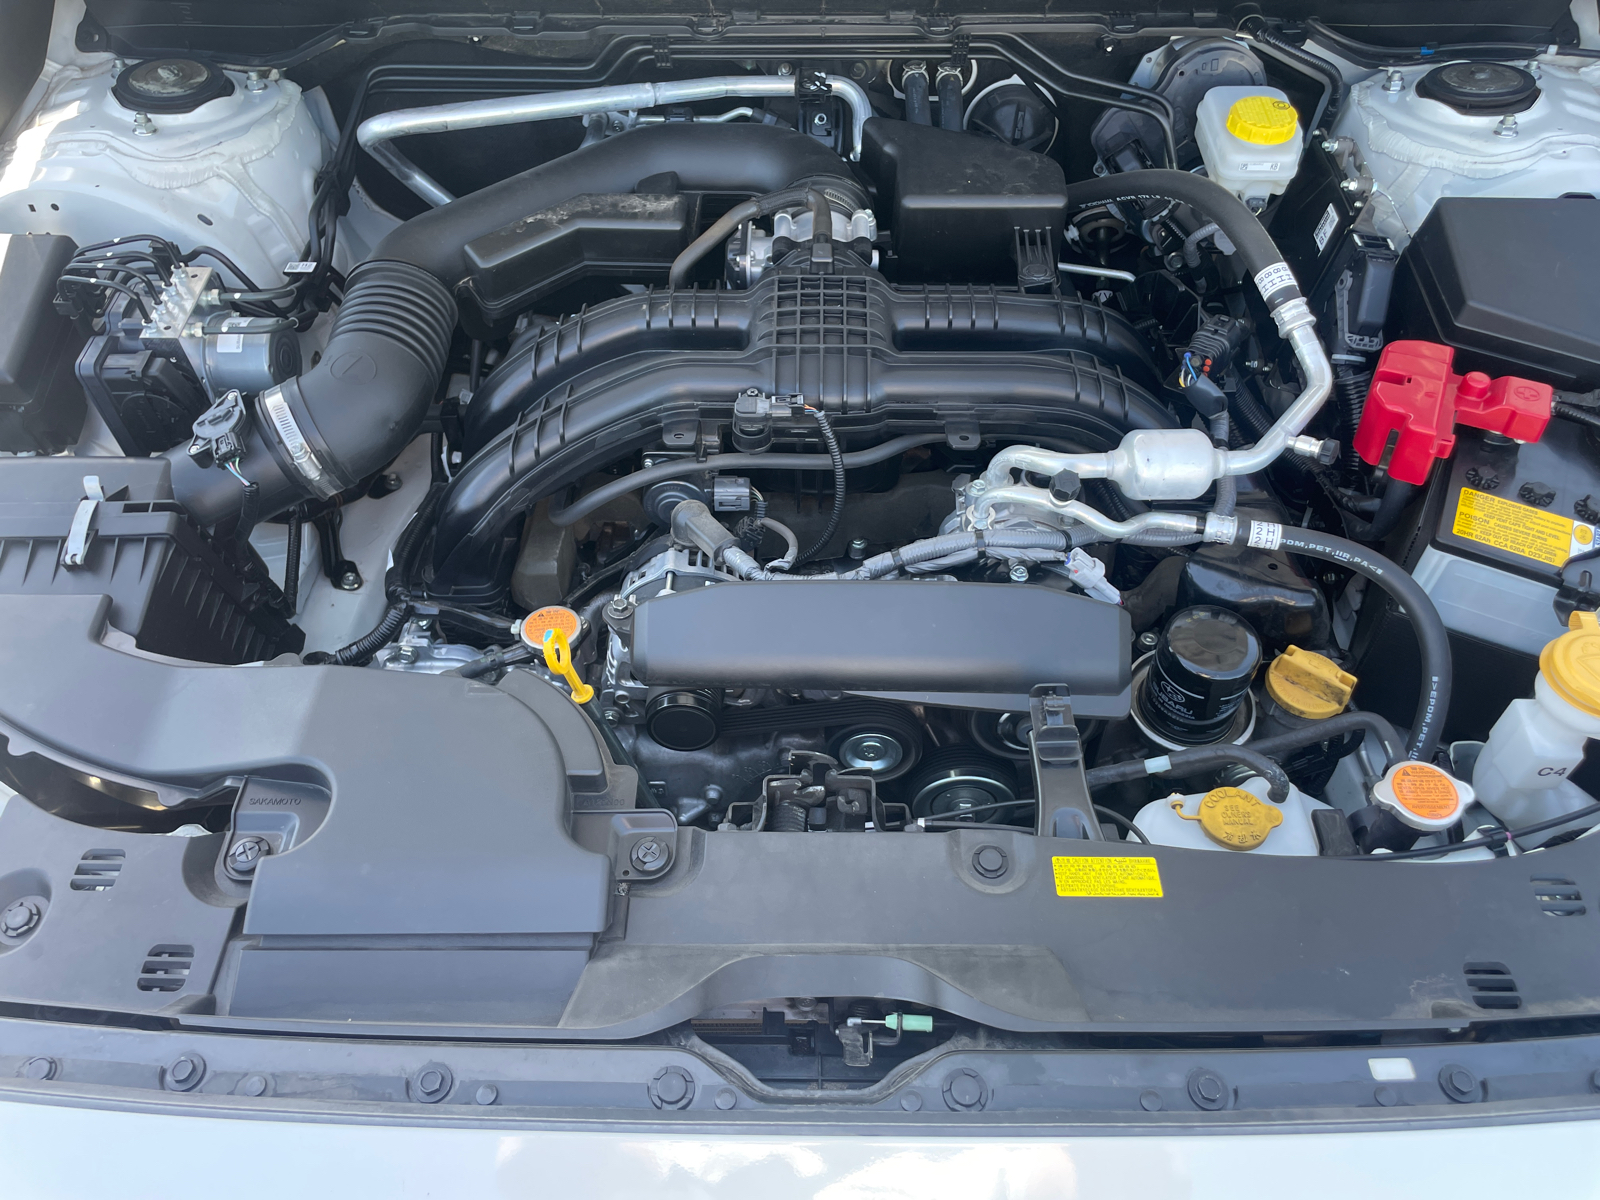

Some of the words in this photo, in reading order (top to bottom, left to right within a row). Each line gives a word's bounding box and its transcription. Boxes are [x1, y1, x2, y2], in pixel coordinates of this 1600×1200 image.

[1463, 489, 1495, 503] DANGER
[1459, 511, 1490, 525] POISON
[1493, 540, 1509, 549] CCA
[1537, 766, 1567, 776] C4
[1204, 789, 1261, 808] COOLANT
